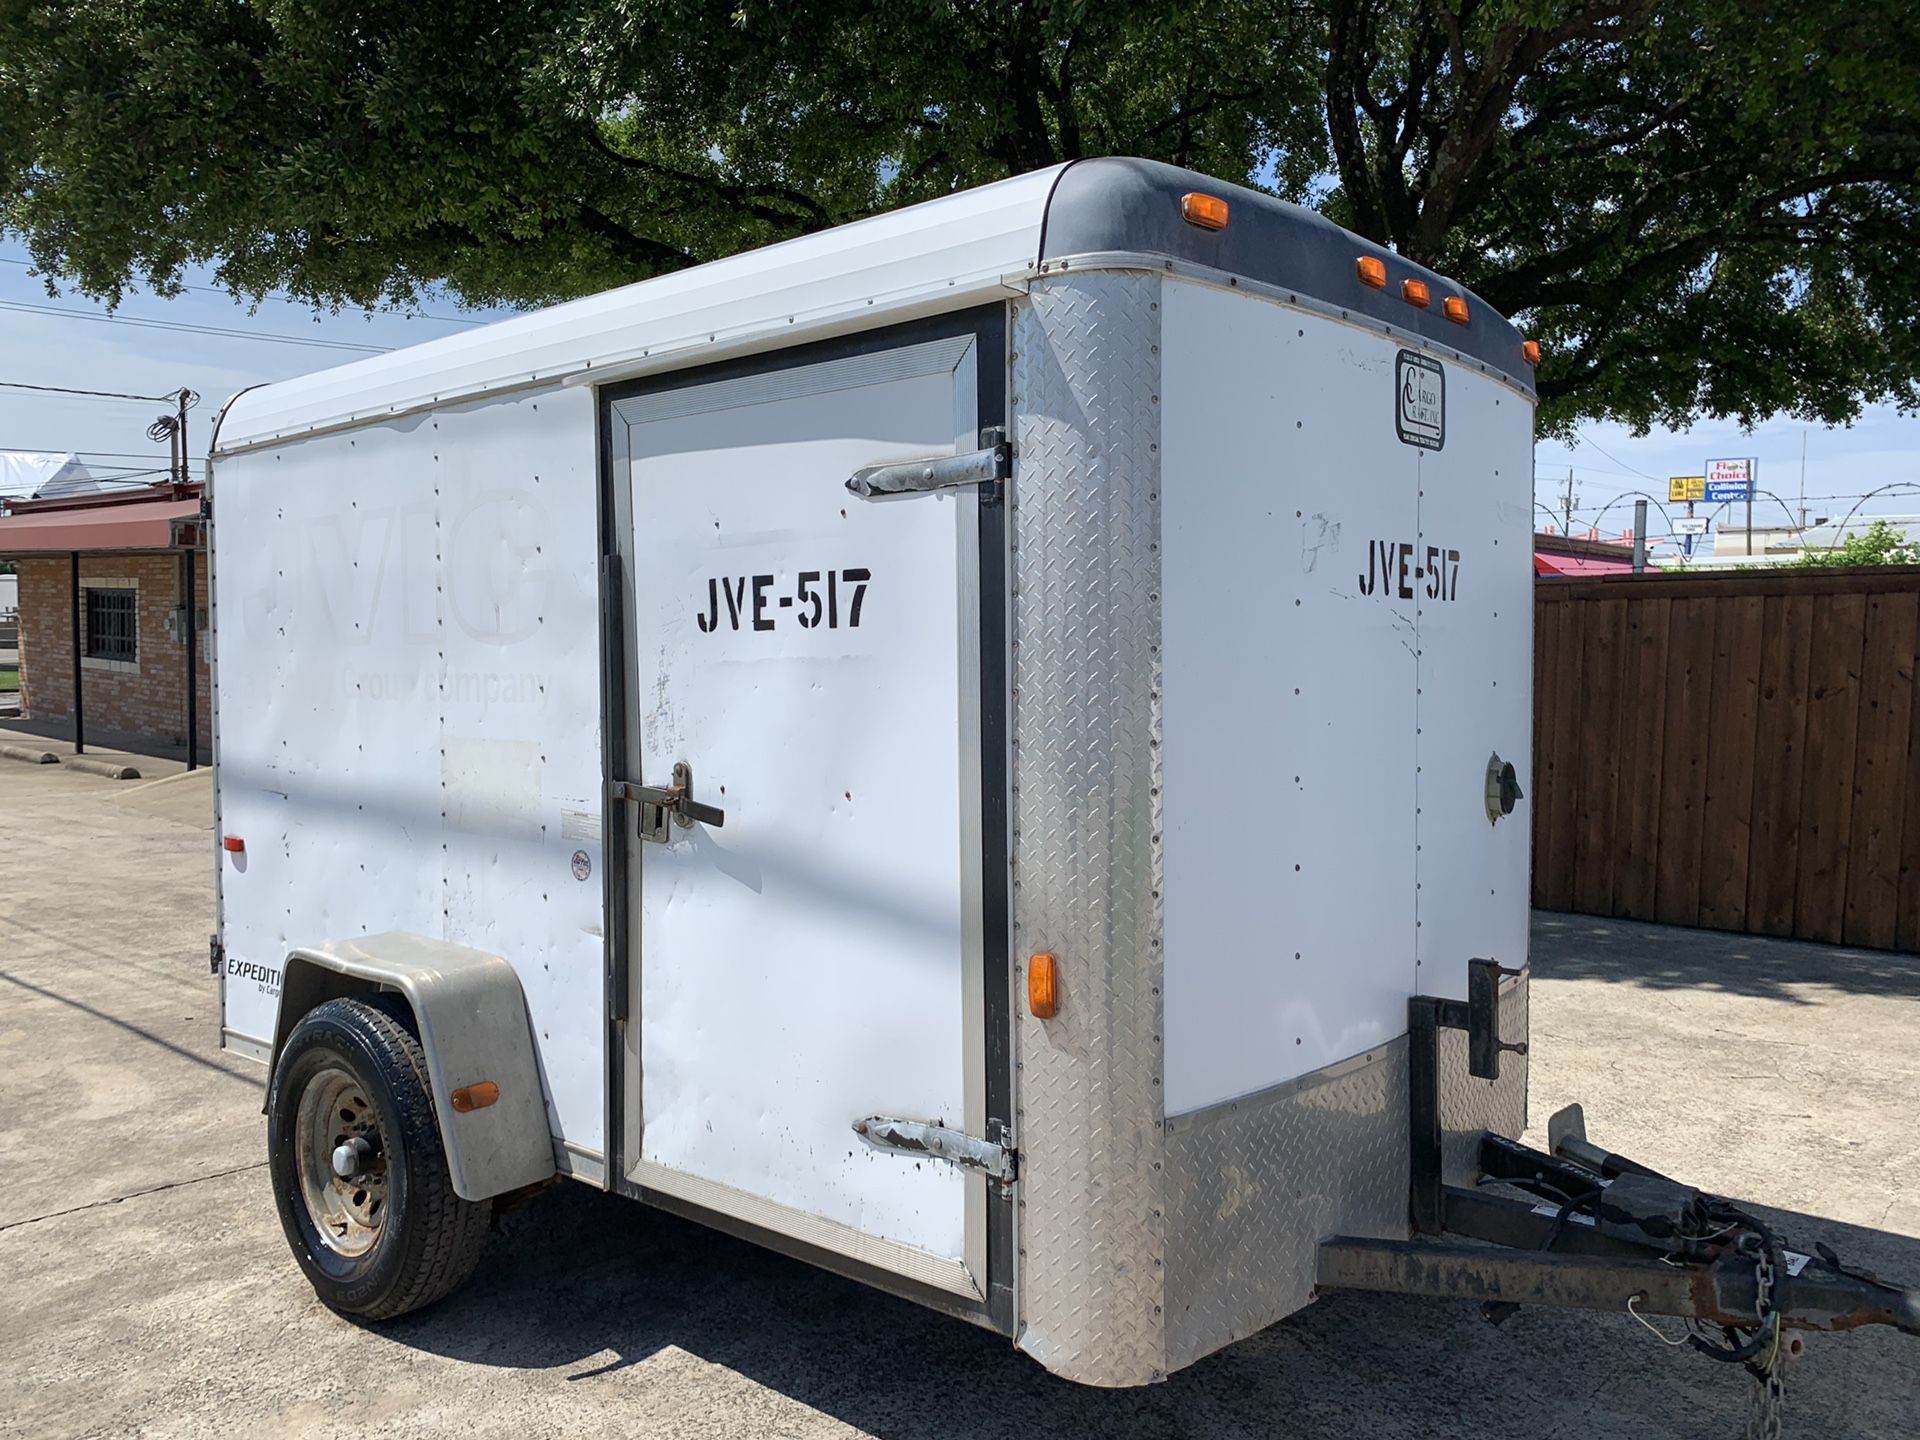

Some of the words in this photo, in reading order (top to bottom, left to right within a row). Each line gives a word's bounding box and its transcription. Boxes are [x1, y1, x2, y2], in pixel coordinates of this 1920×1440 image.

[1359, 540, 1460, 601] JVE-517
[697, 568, 872, 633] JVE-517
[228, 959, 281, 986] EXPEDITI
[258, 983, 266, 994] by
